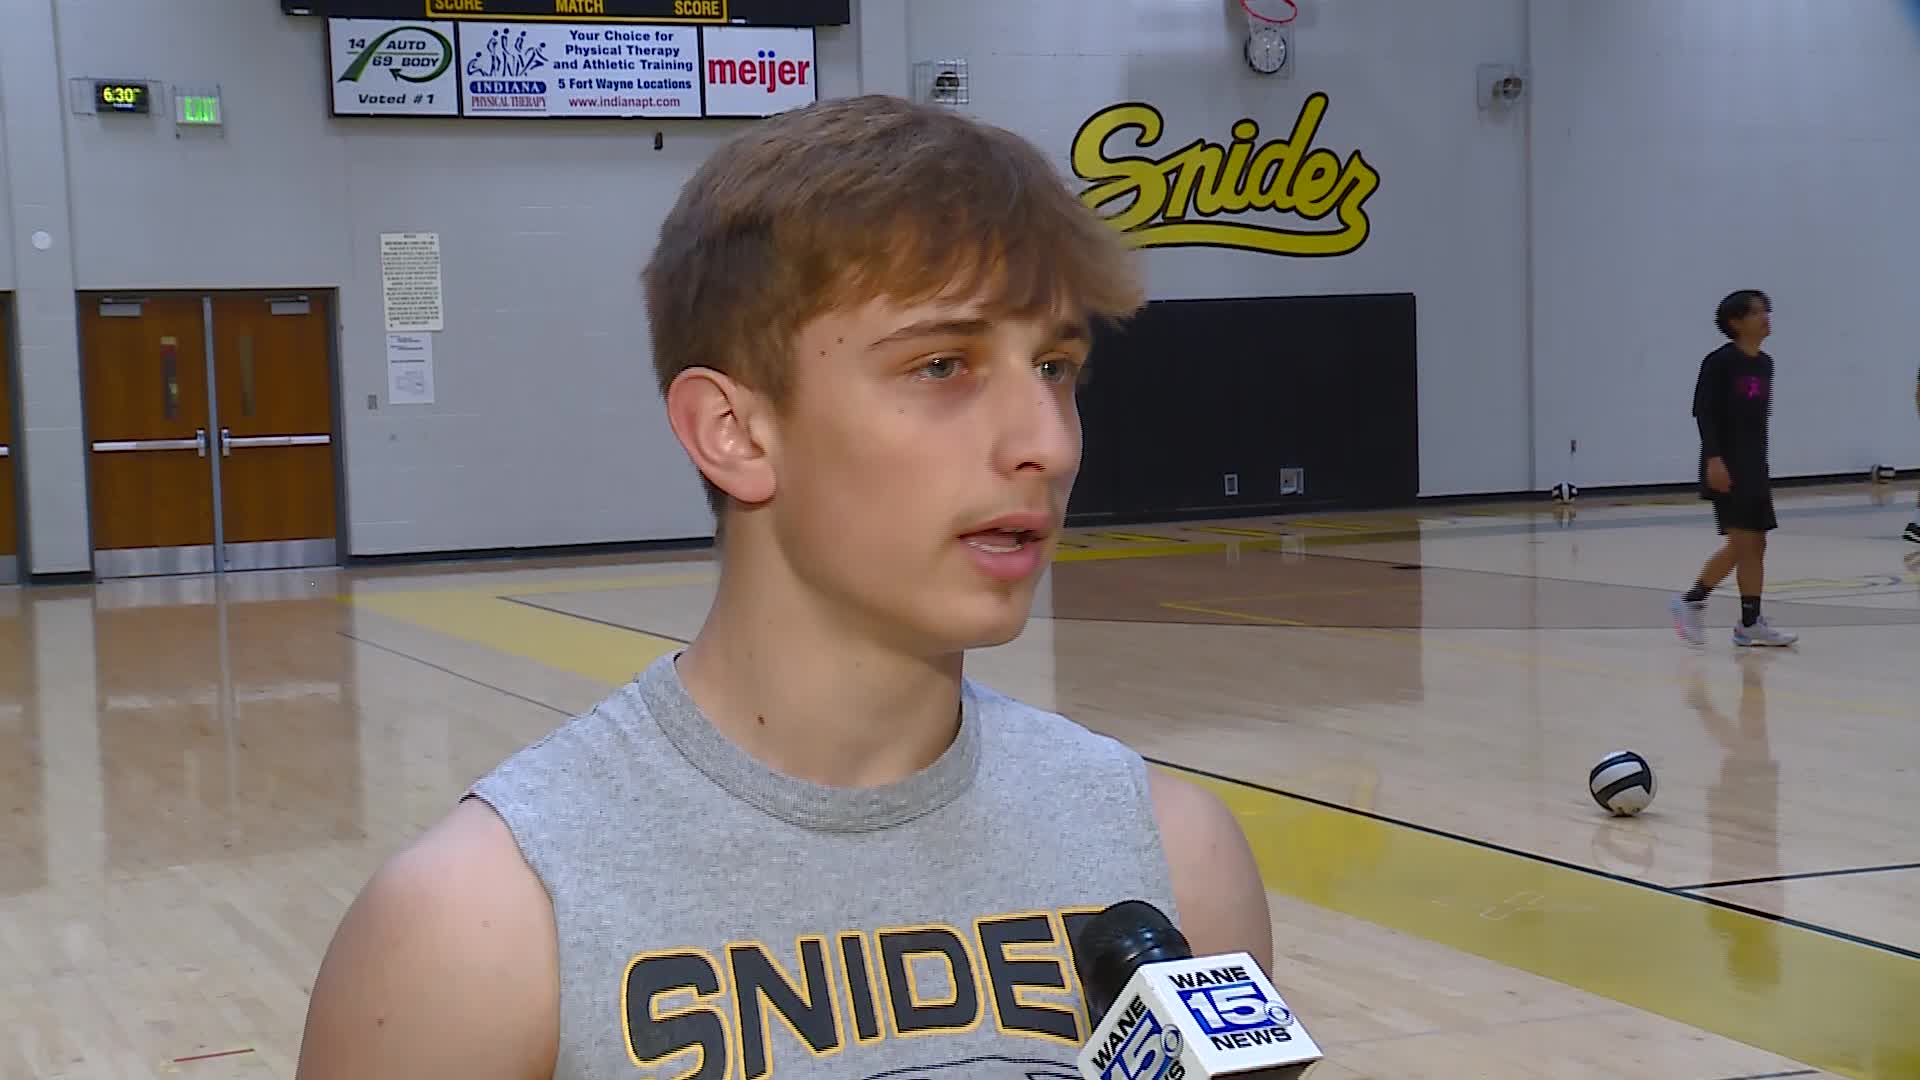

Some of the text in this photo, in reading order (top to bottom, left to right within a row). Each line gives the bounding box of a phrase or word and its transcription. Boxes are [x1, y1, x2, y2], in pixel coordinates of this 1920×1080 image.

[556, 0, 604, 14] MATCH
[674, 0, 721, 16] SCORE
[569, 30, 674, 42] Your Choice for
[348, 38, 426, 51] 14 AUTO
[565, 44, 680, 59] Physical Therapy
[372, 56, 440, 68] 69 BODY
[553, 59, 693, 73] and Athletic Training
[708, 50, 810, 93] meijer
[474, 81, 542, 94] INDIANA
[558, 78, 692, 91] 5 Fort Wayne Locations
[358, 93, 406, 105] Voted
[471, 96, 547, 108] PHYSICAL THERAPY
[569, 96, 680, 109] www.indianapt.com
[1071, 92, 1380, 257] Snider
[1169, 965, 1252, 990] WANE
[1183, 983, 1268, 1032] 15
[1091, 994, 1148, 1071] WANE
[1210, 1026, 1293, 1051] NEWS
